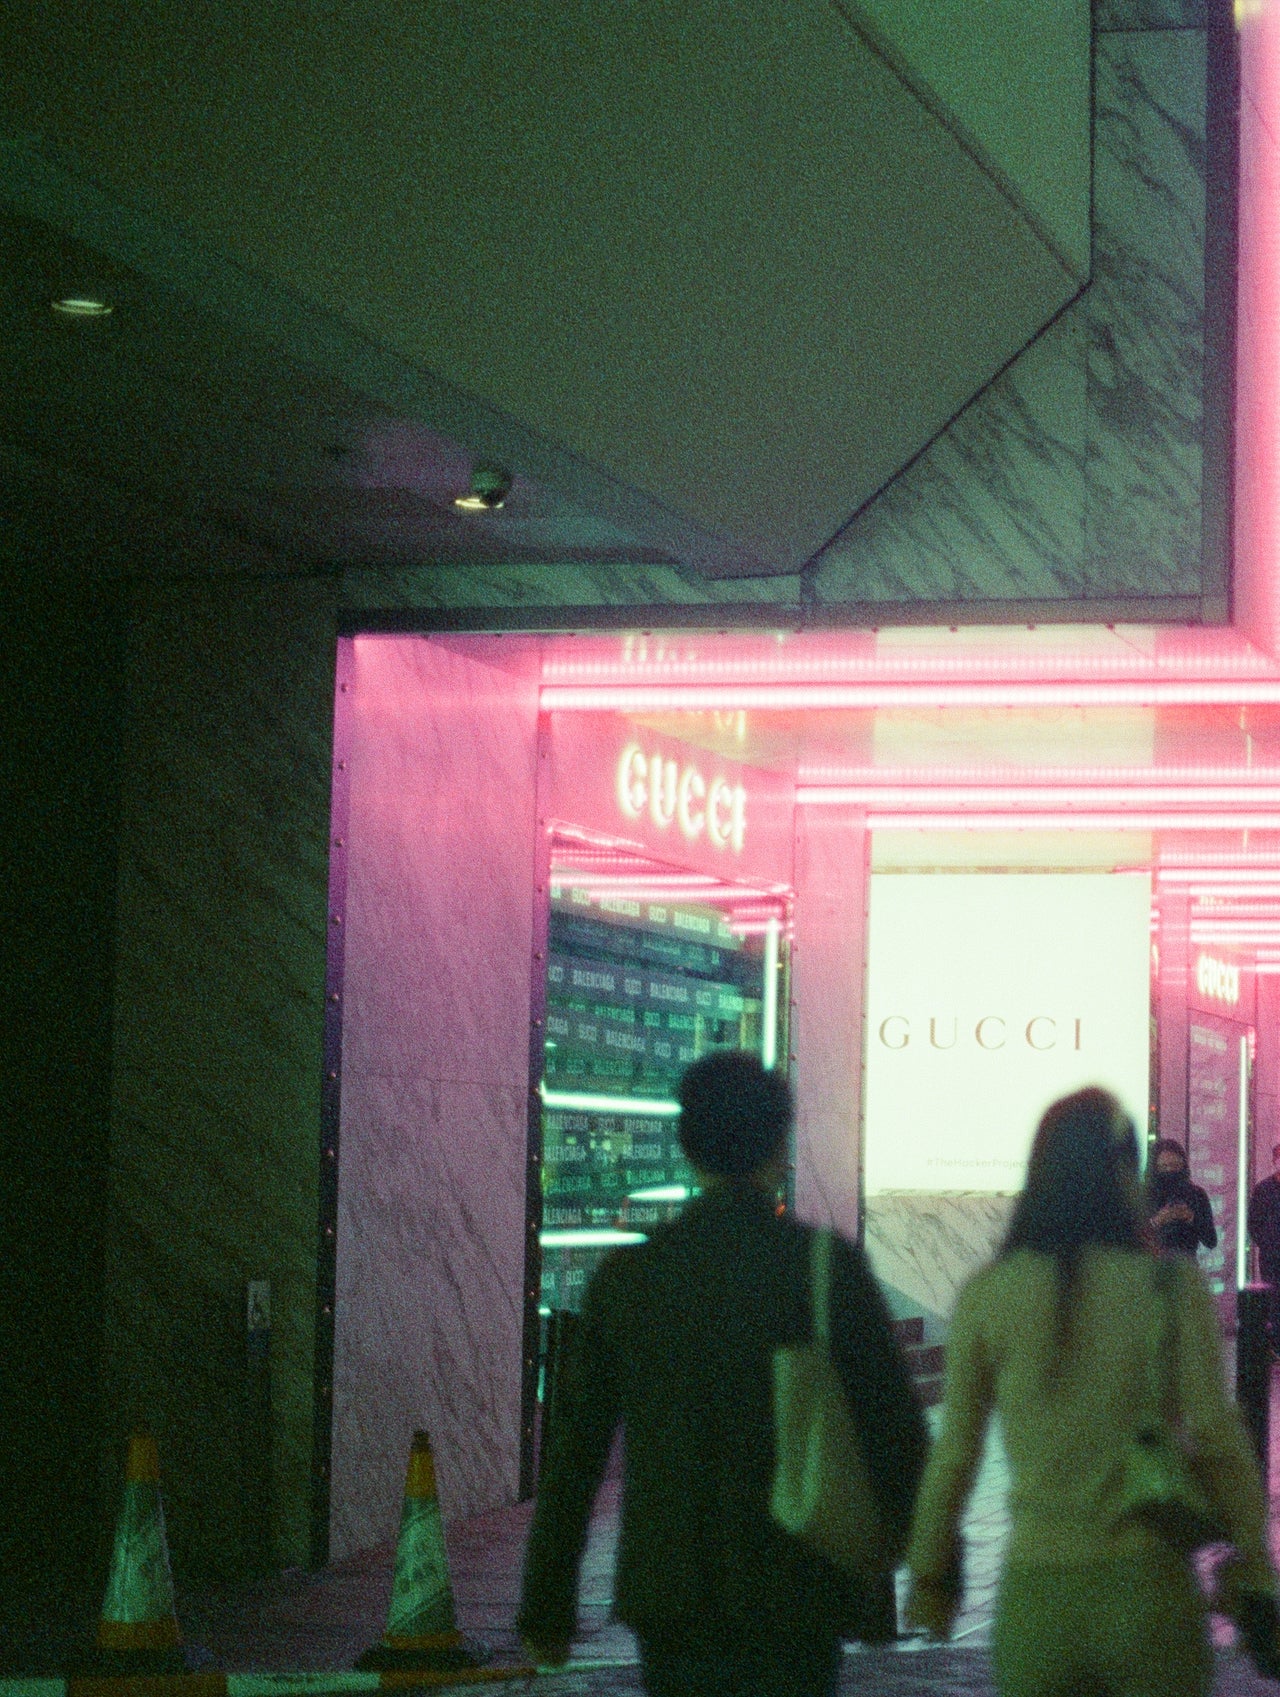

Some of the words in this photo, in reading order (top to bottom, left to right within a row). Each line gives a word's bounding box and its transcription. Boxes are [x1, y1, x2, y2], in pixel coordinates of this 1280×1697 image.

[617, 743, 747, 853] GUCCI
[1198, 955, 1240, 1003] GUCCI
[879, 1015, 1081, 1050] GUCCI
